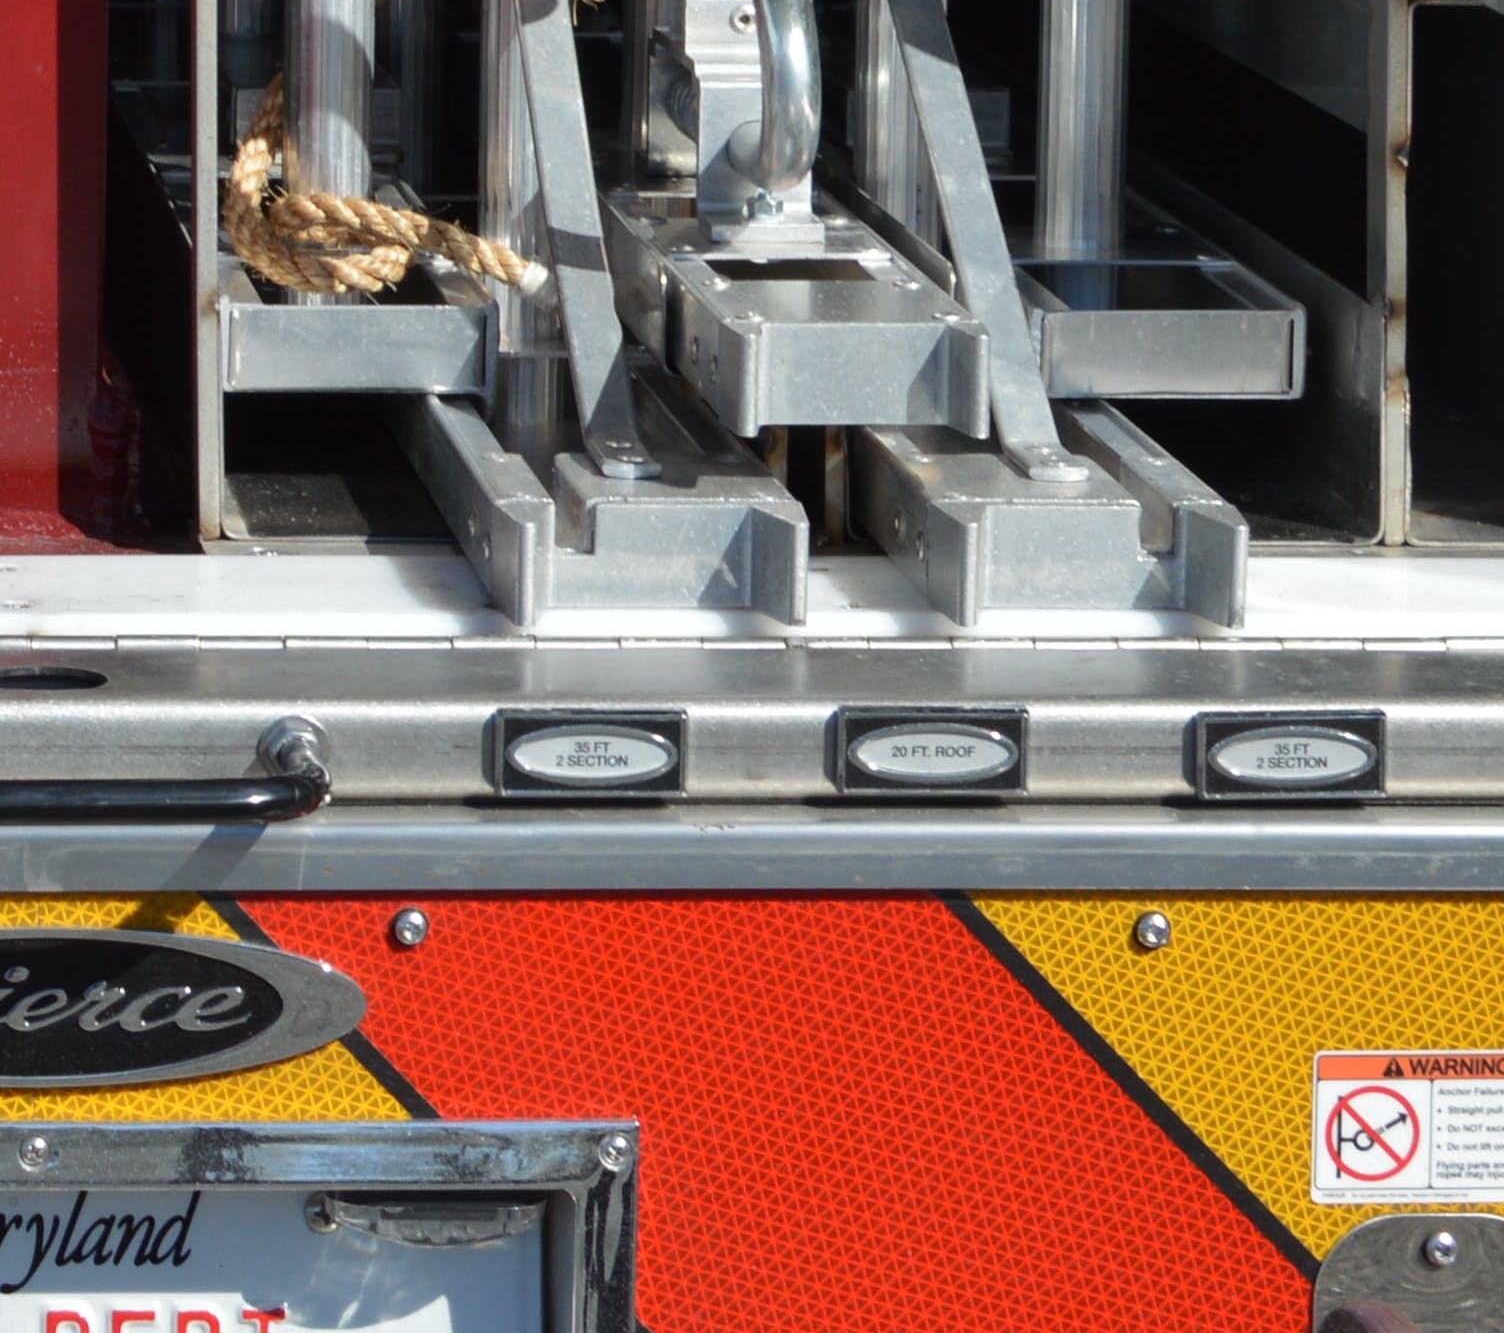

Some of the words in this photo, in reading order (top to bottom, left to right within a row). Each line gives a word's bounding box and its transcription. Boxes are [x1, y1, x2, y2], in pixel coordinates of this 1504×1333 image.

[574, 741, 589, 754] 35
[592, 741, 610, 754] FT
[891, 745, 906, 758] 20
[909, 745, 932, 758] FT.
[934, 745, 977, 758] ROOF
[1273, 743, 1289, 755] 35
[1291, 743, 1311, 755] FT
[555, 755, 565, 767] 2
[567, 755, 629, 767] SECTION
[1256, 757, 1265, 770] 2
[1267, 757, 1328, 770] SECTION
[1438, 1088, 1471, 1096] Anchor
[1447, 1124, 1460, 1133] Do
[1463, 1124, 1483, 1133] NOT
[1447, 1142, 1460, 1151] Do
[1436, 1161, 1464, 1171] Flying
